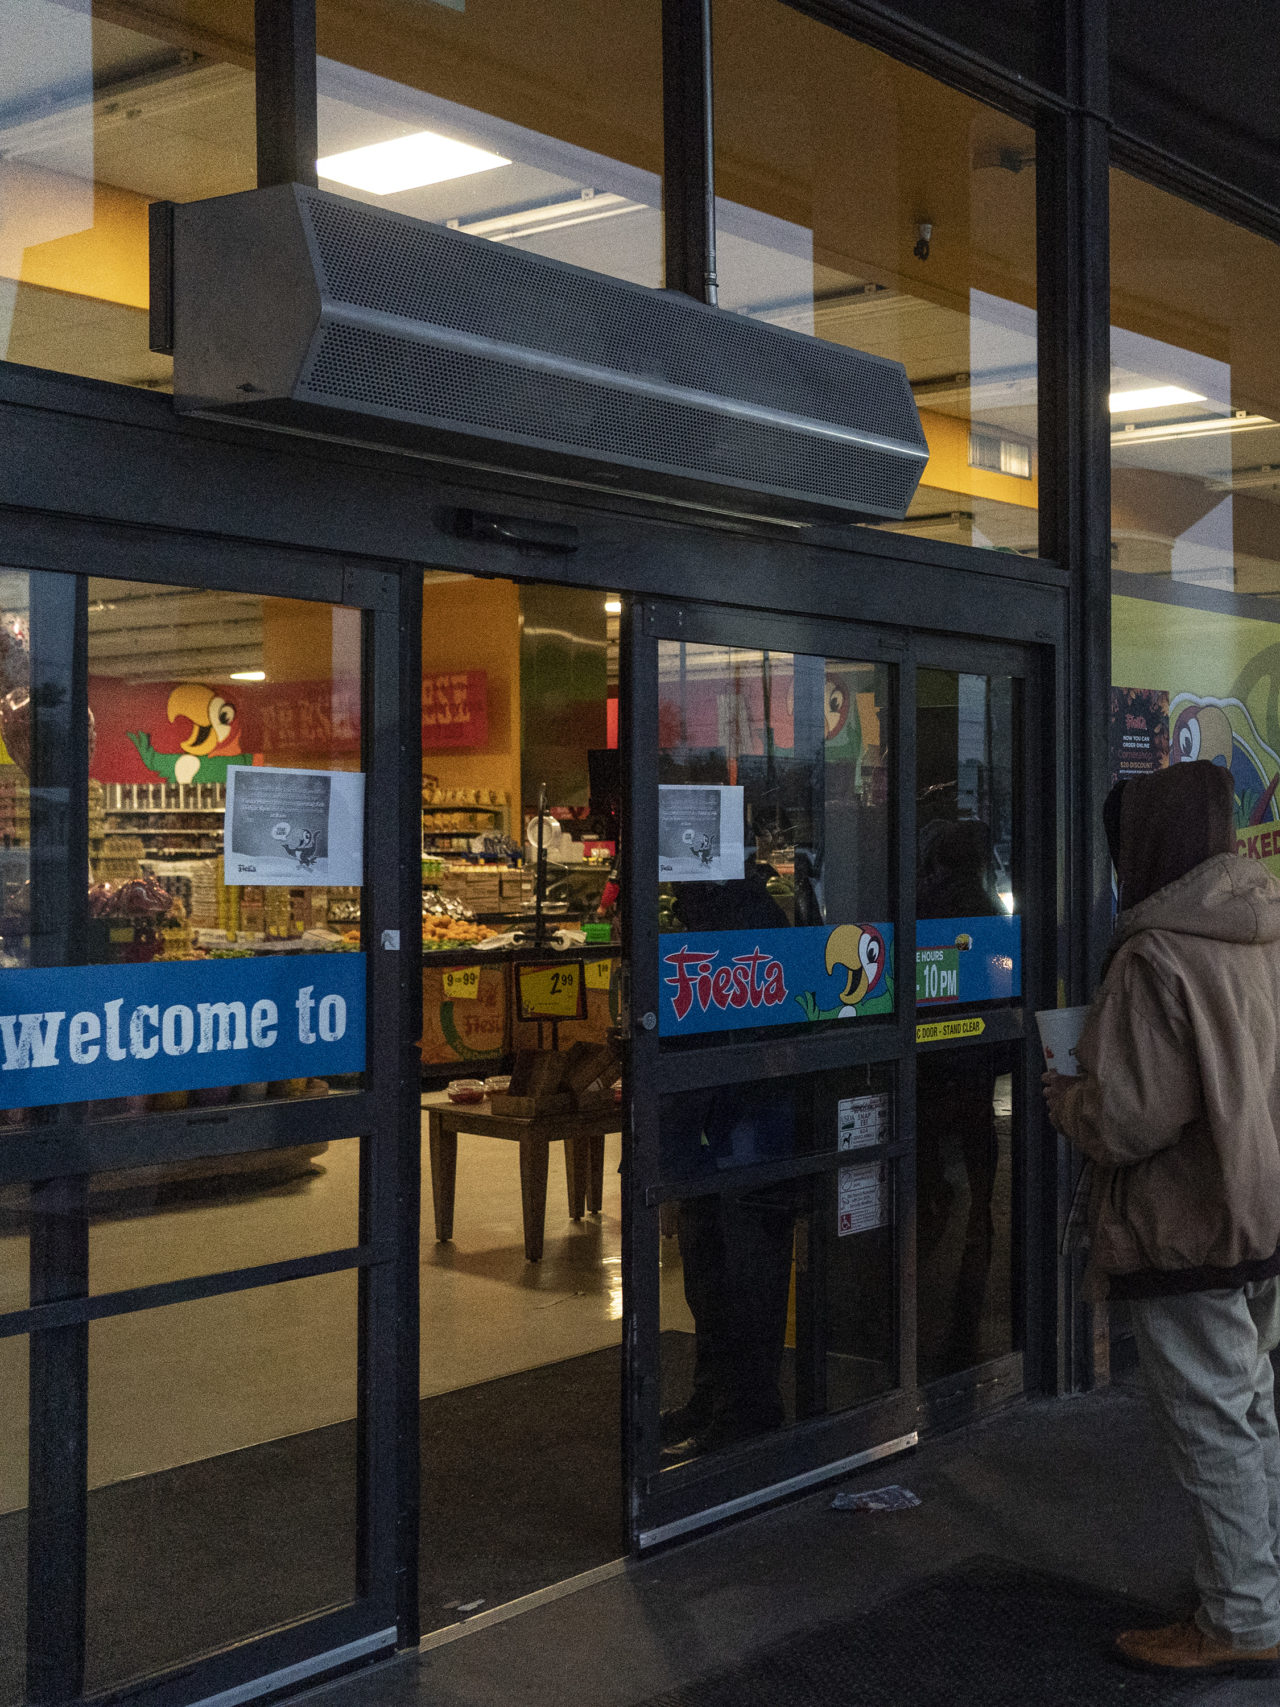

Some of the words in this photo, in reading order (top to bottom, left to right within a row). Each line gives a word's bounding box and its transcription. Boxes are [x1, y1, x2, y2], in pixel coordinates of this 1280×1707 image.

[921, 950, 944, 961] HOURS
[664, 944, 789, 1021] Fiesta
[924, 964, 938, 998] 10
[940, 969, 957, 997] PM
[296, 985, 348, 1045] to
[922, 1026, 938, 1039] DOOR
[943, 1023, 961, 1036] STAND
[962, 1021, 980, 1034] CLEAR
